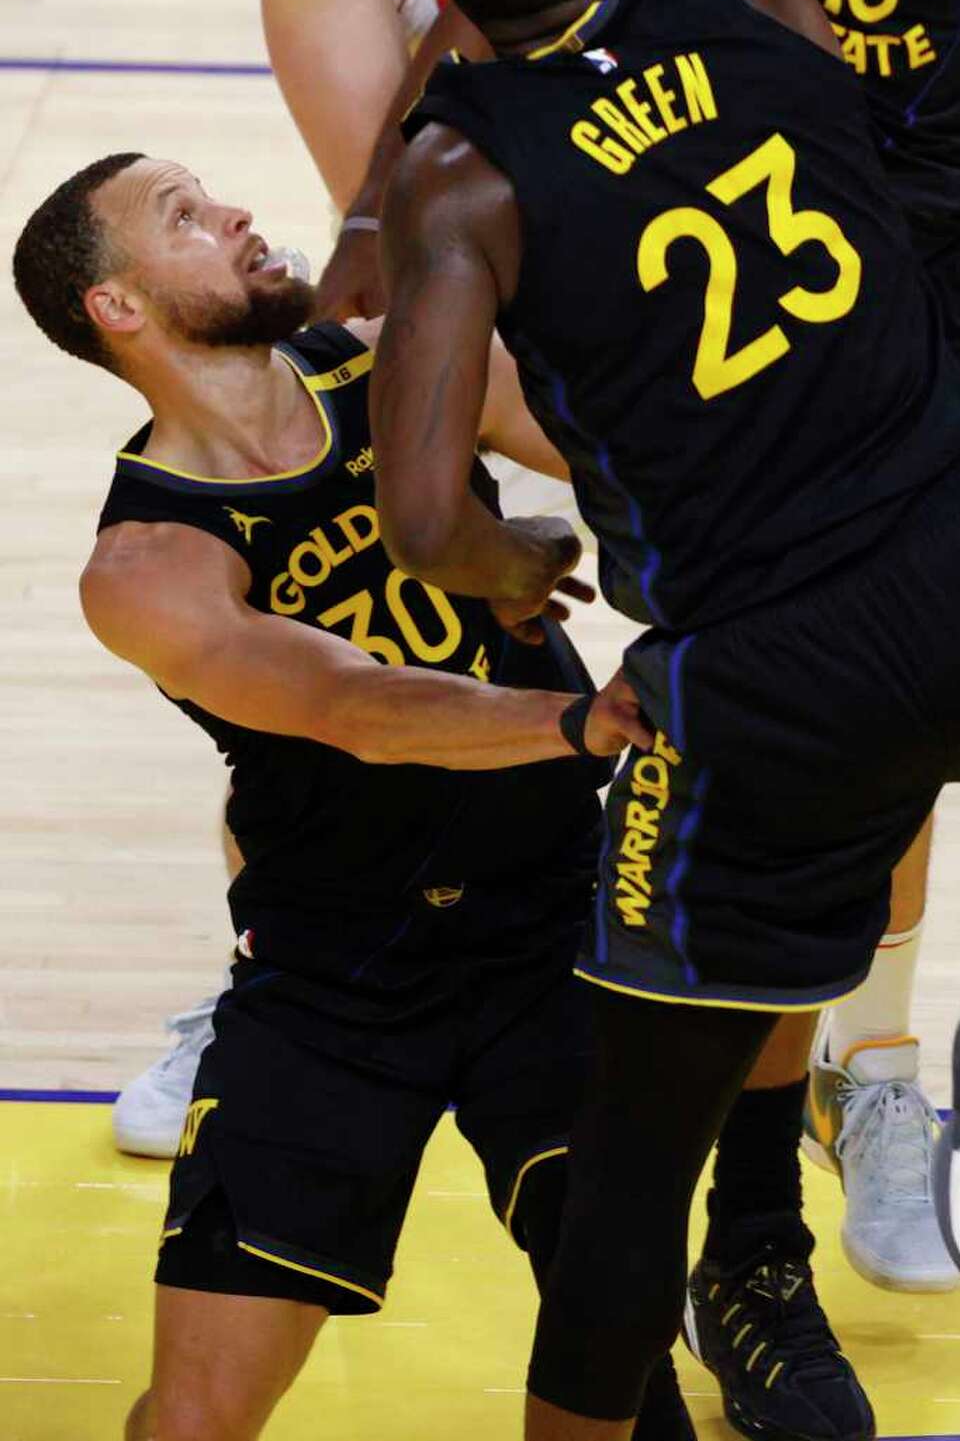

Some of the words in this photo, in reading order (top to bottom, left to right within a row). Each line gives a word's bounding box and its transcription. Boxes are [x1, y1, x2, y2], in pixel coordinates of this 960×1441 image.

[831, 22, 937, 78] ATE
[570, 52, 719, 176] GREEN
[636, 131, 863, 401] 23
[332, 366, 352, 385] 16
[269, 504, 382, 616] GOLD
[316, 567, 463, 667] 30
